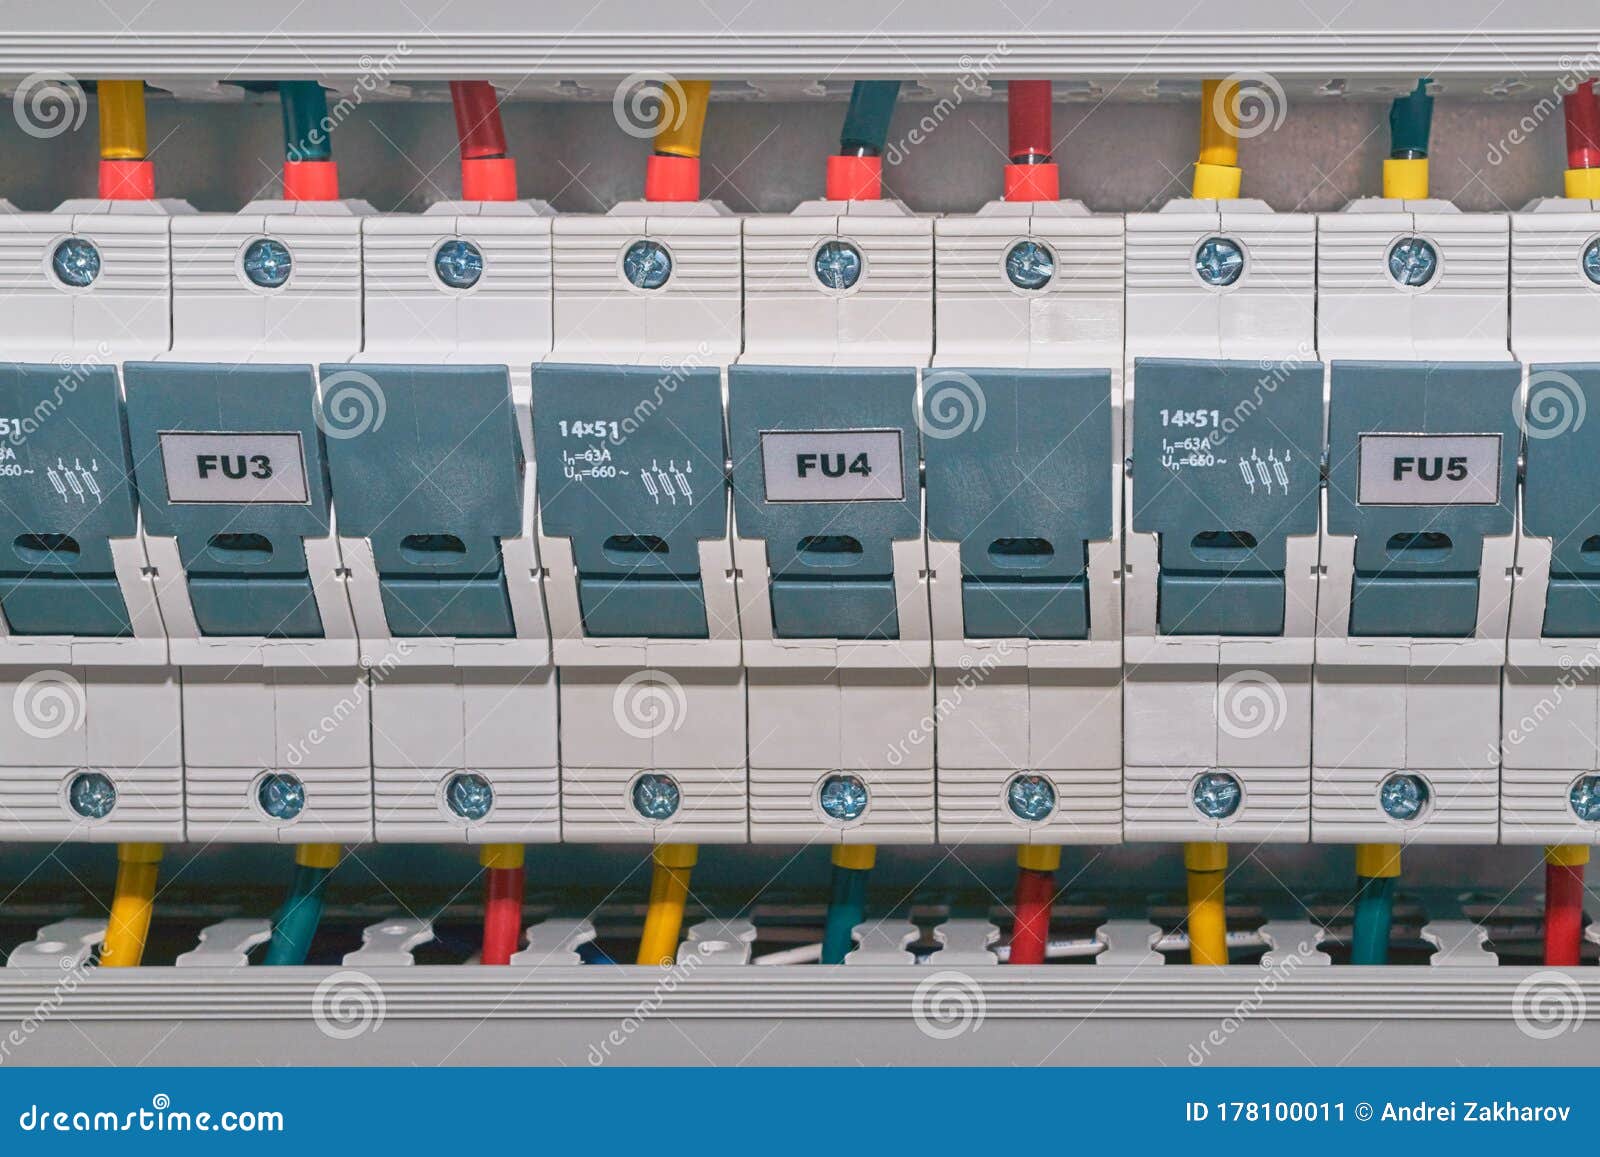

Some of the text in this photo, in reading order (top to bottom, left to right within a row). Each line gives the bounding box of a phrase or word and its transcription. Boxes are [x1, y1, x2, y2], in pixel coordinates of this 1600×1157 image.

[197, 454, 273, 480] FU3
[796, 452, 872, 479] FU4
[1393, 456, 1468, 481] FU5
